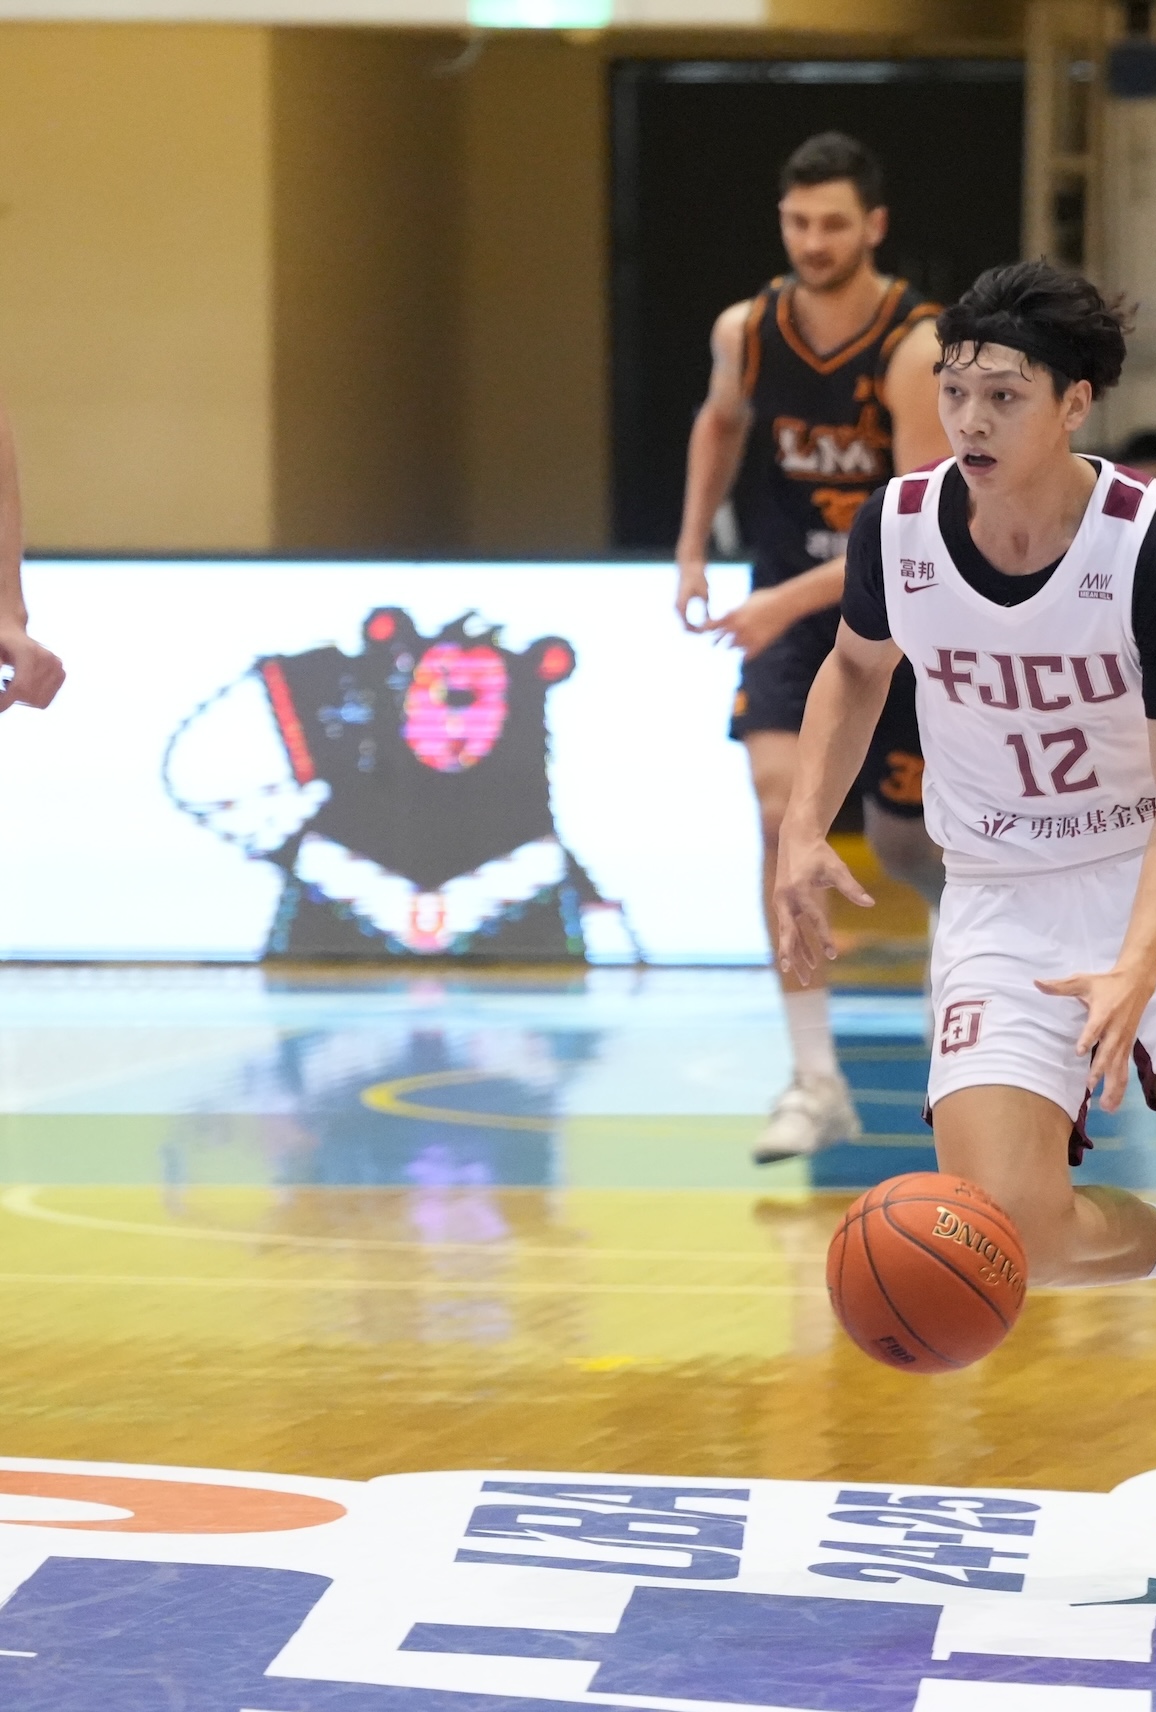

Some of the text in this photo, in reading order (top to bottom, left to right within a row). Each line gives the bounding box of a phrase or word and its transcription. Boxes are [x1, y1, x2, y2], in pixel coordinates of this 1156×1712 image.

[900, 558, 935, 580] 富邦
[1079, 572, 1113, 590] MW
[923, 646, 1130, 713] FJCU
[1004, 727, 1101, 798] 12
[1030, 796, 1156, 840] 勇源基金會
[931, 1206, 1026, 1306] PALDING
[453, 1480, 751, 1582] UBA
[807, 1489, 1043, 1593] 24-25
